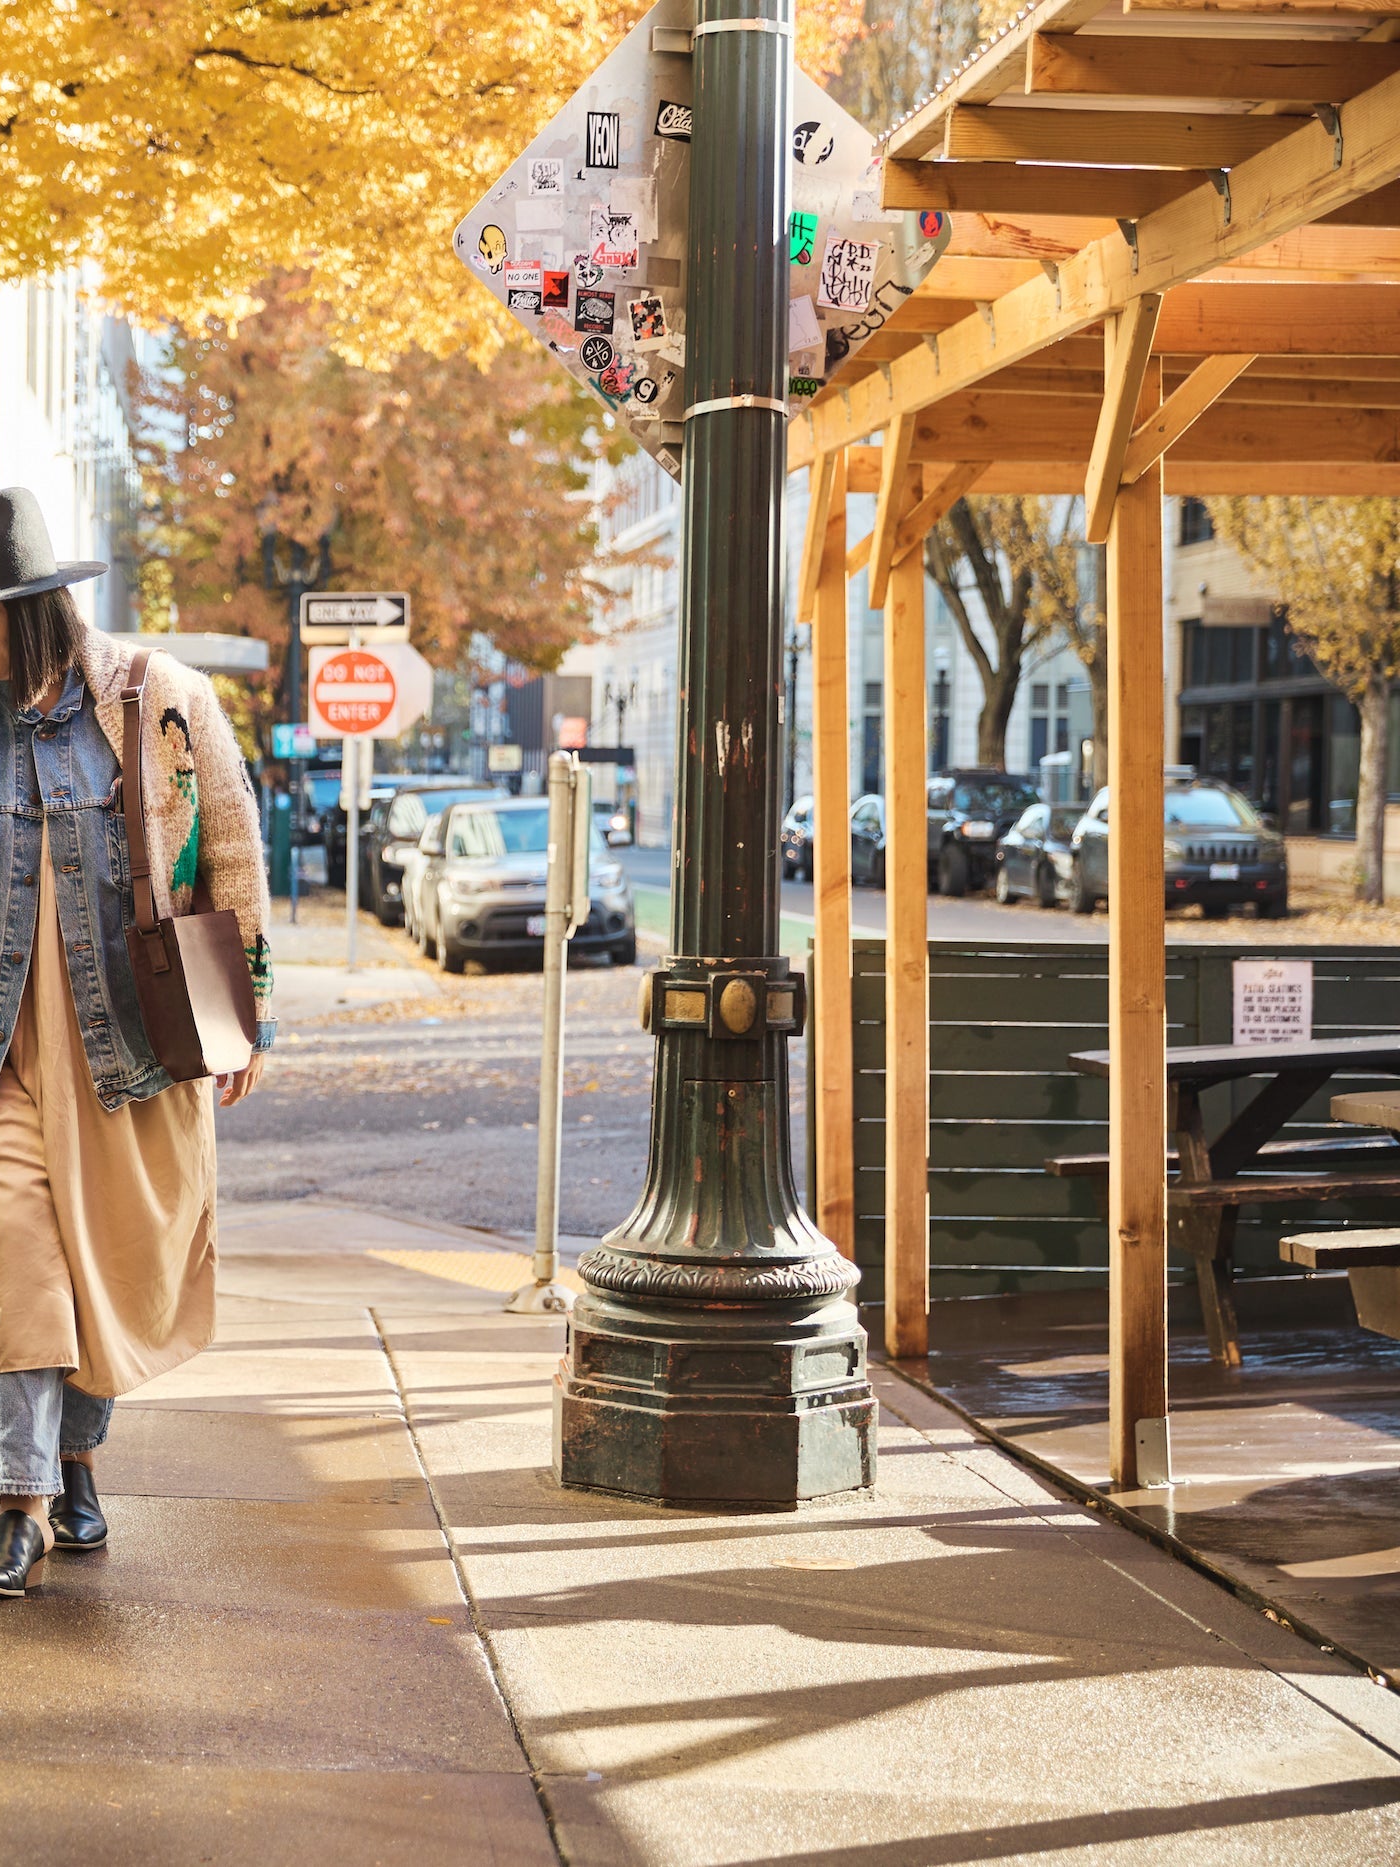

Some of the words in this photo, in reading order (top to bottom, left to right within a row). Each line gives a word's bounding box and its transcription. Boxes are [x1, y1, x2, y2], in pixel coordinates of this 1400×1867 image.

[589, 114, 618, 166] YEON
[508, 273, 520, 281] NO
[522, 273, 539, 281] ONE
[314, 607, 341, 621] ONE
[347, 606, 376, 621] WAY
[322, 664, 347, 682] DO
[354, 664, 386, 682] NOT
[328, 703, 381, 721] ENTER
